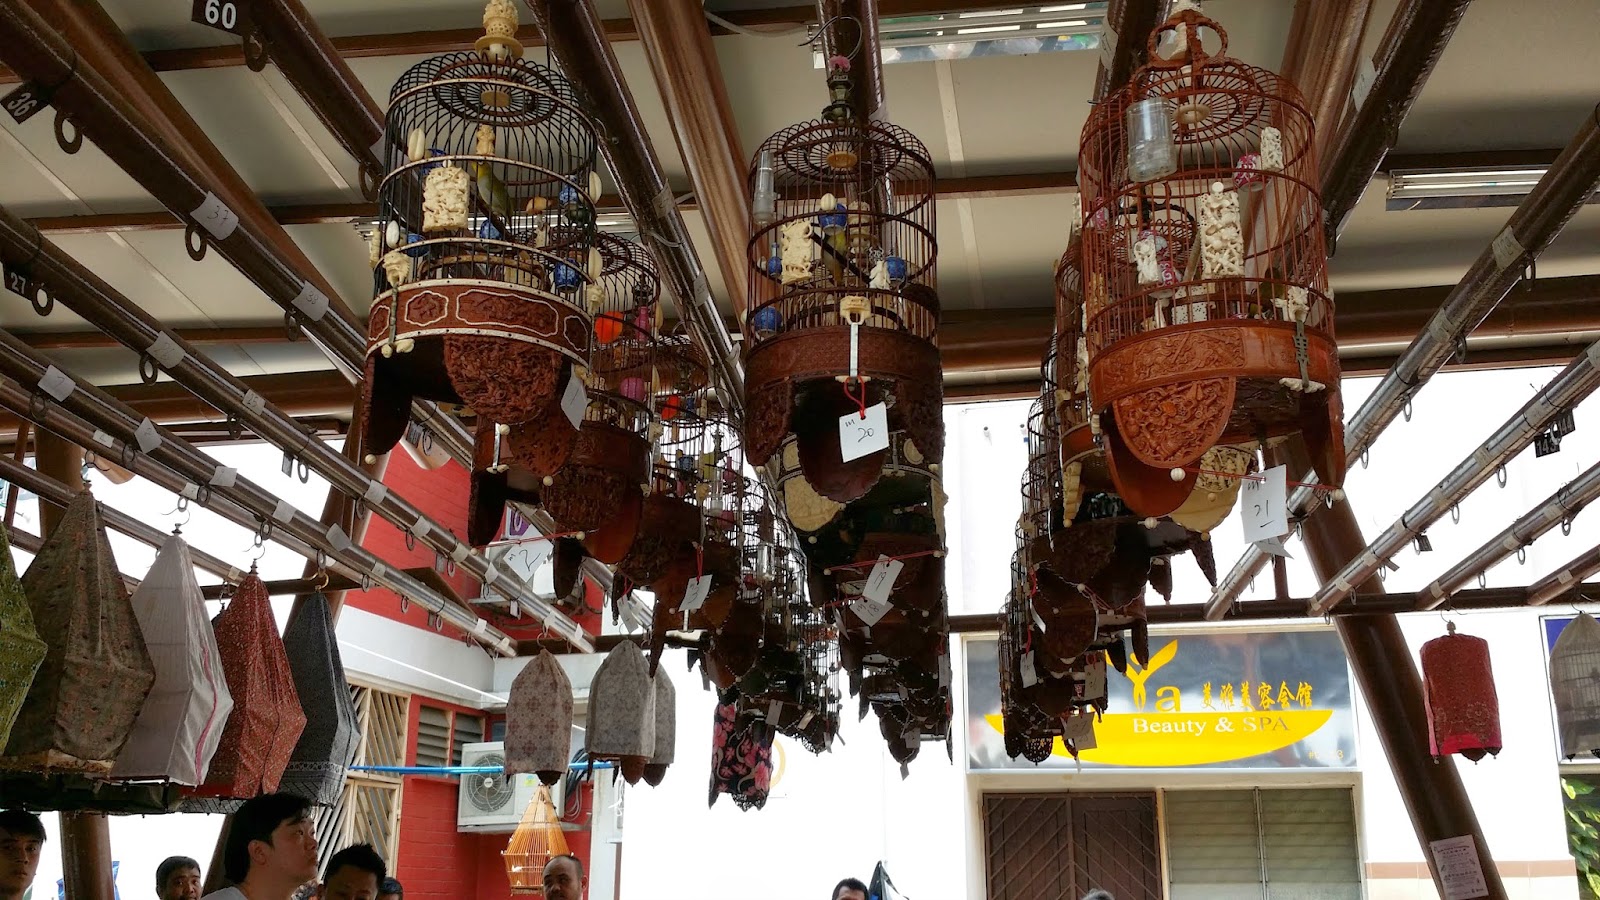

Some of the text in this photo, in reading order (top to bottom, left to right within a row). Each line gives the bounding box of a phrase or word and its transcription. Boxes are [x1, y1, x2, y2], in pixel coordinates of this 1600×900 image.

[205, 0, 237, 29] 60
[7, 92, 38, 117] 36
[206, 204, 229, 226] 37
[10, 271, 26, 295] 27
[857, 427, 875, 443] 20
[518, 548, 542, 573] 2
[1133, 716, 1291, 738] Beauty & SPA
